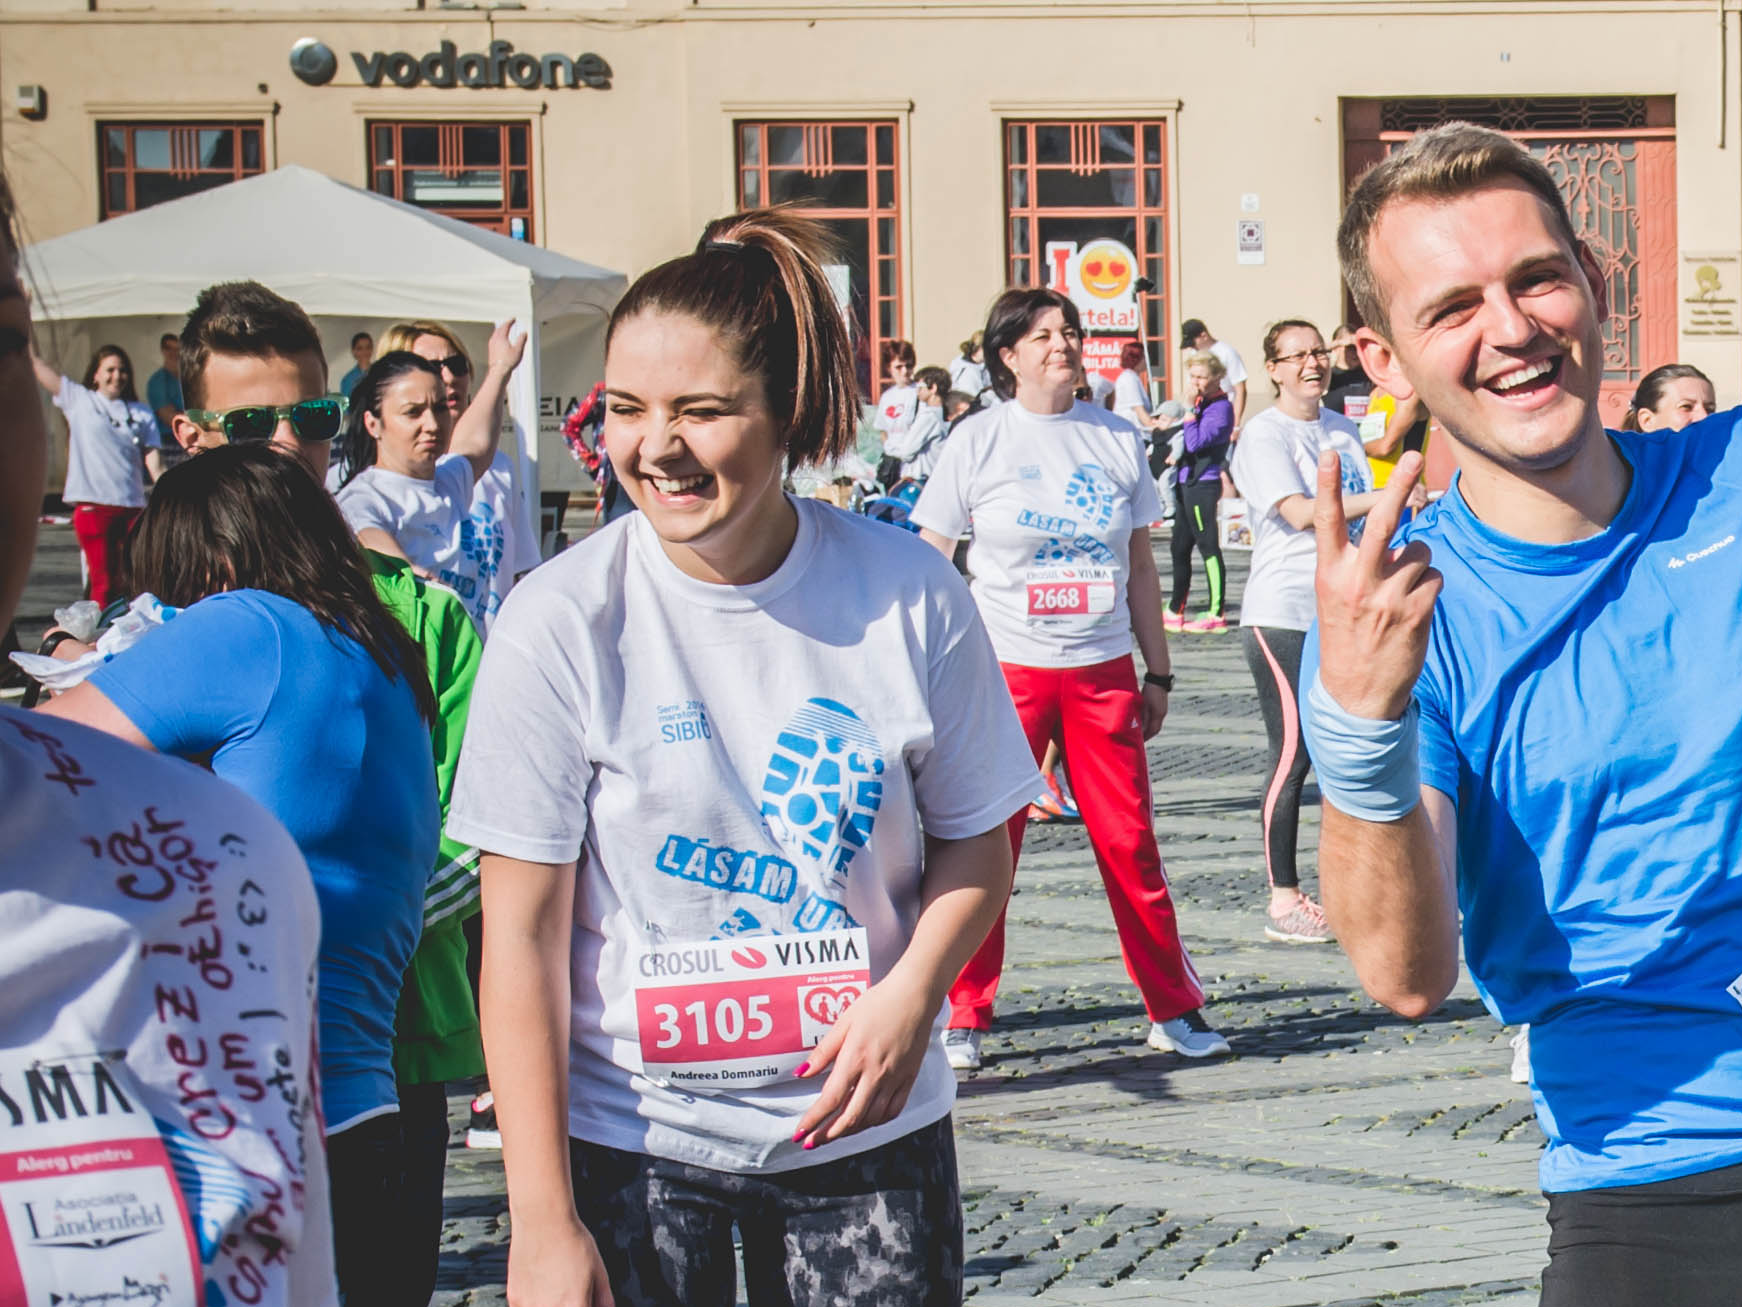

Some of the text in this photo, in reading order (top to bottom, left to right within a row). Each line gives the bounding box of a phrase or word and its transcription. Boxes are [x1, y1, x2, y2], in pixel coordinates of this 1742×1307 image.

[349, 40, 612, 89] vodafone
[1686, 535, 1735, 562] Quechua
[1033, 588, 1080, 609] 2668
[639, 938, 860, 977] CROSUL VISMA
[654, 995, 773, 1049] 3105
[671, 1066, 778, 1080] Andreea Domnariu
[16, 1149, 134, 1173] Alerg pentru
[23, 1201, 165, 1240] Lindenfeld
